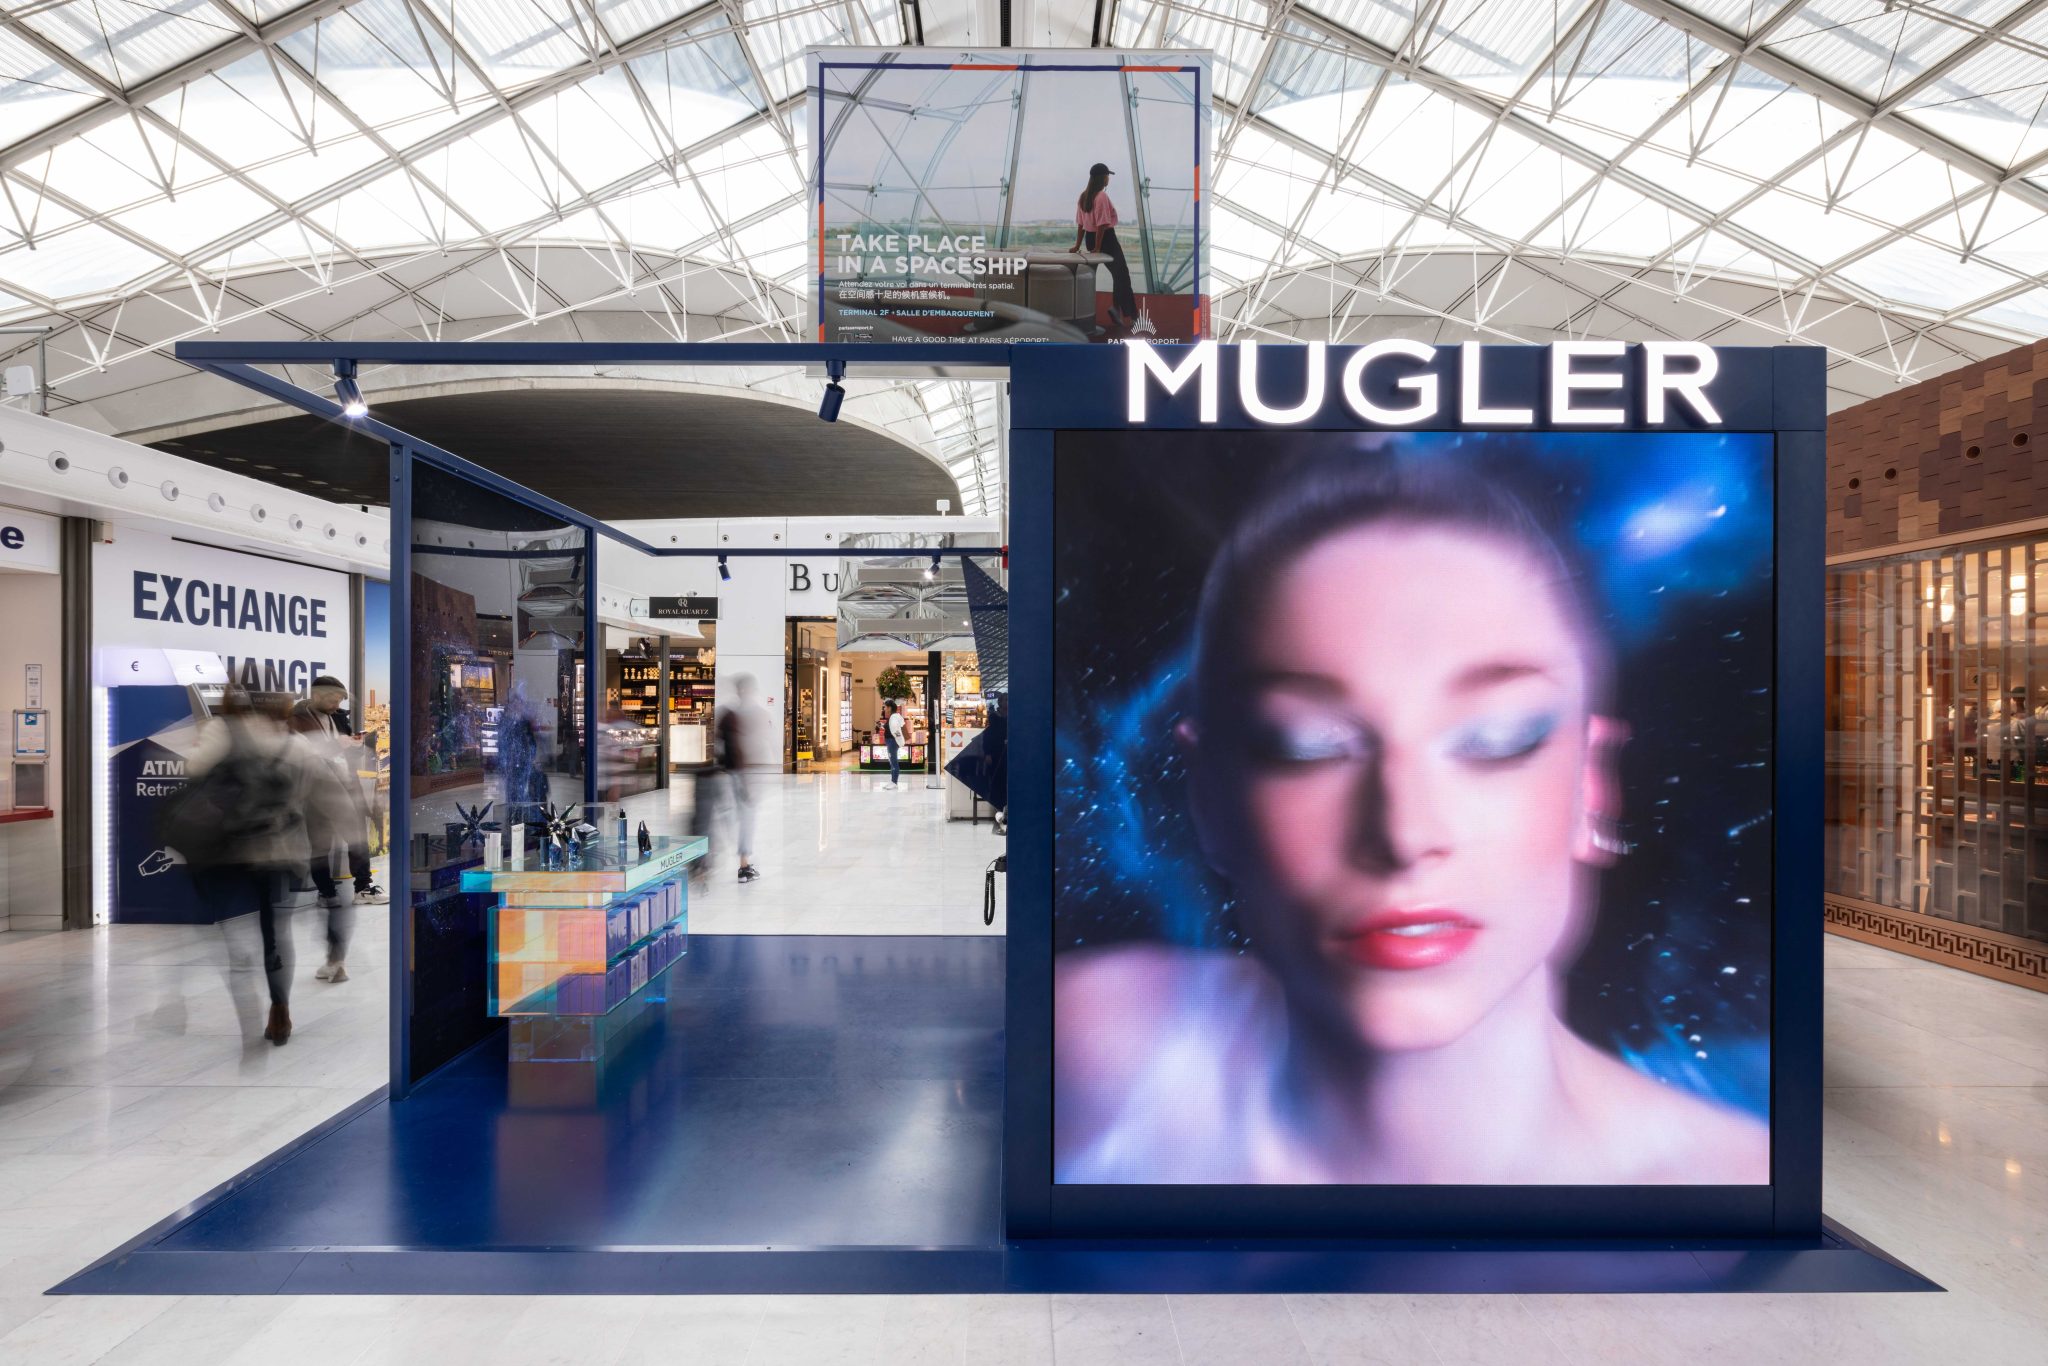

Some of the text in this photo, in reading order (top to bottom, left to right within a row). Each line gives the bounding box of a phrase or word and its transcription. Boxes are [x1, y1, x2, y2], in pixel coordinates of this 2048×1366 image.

[837, 234, 986, 254] TAKE PLACE
[837, 256, 1028, 276] IN A SPACESHIP
[838, 290, 951, 300] 在空间感十足的候机室候机。
[989, 283, 1015, 291] spatial.
[1126, 339, 1723, 424] MUGLER
[133, 570, 327, 638] EXCHANGE
[131, 661, 139, 671] €
[143, 760, 185, 777] ATM
[660, 853, 684, 870] MUGLER
